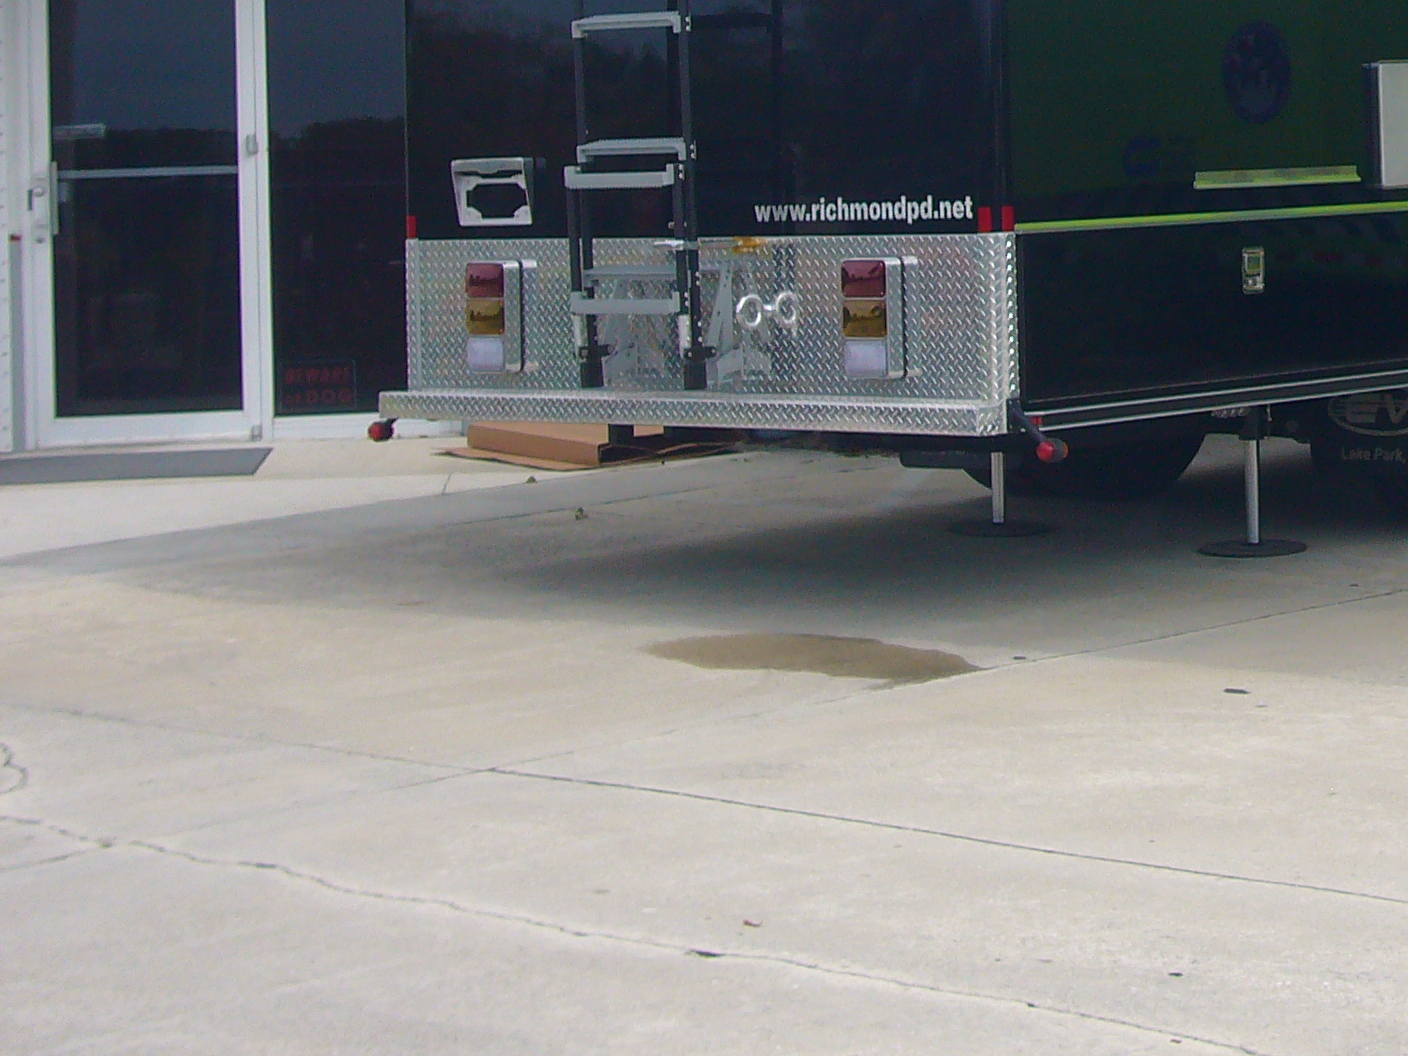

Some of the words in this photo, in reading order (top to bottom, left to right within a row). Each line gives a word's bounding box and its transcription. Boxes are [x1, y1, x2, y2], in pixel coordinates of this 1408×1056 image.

[754, 195, 973, 225] www.richmondpd.net
[1341, 446, 1371, 462] Lake
[1374, 446, 1406, 464] Park,
